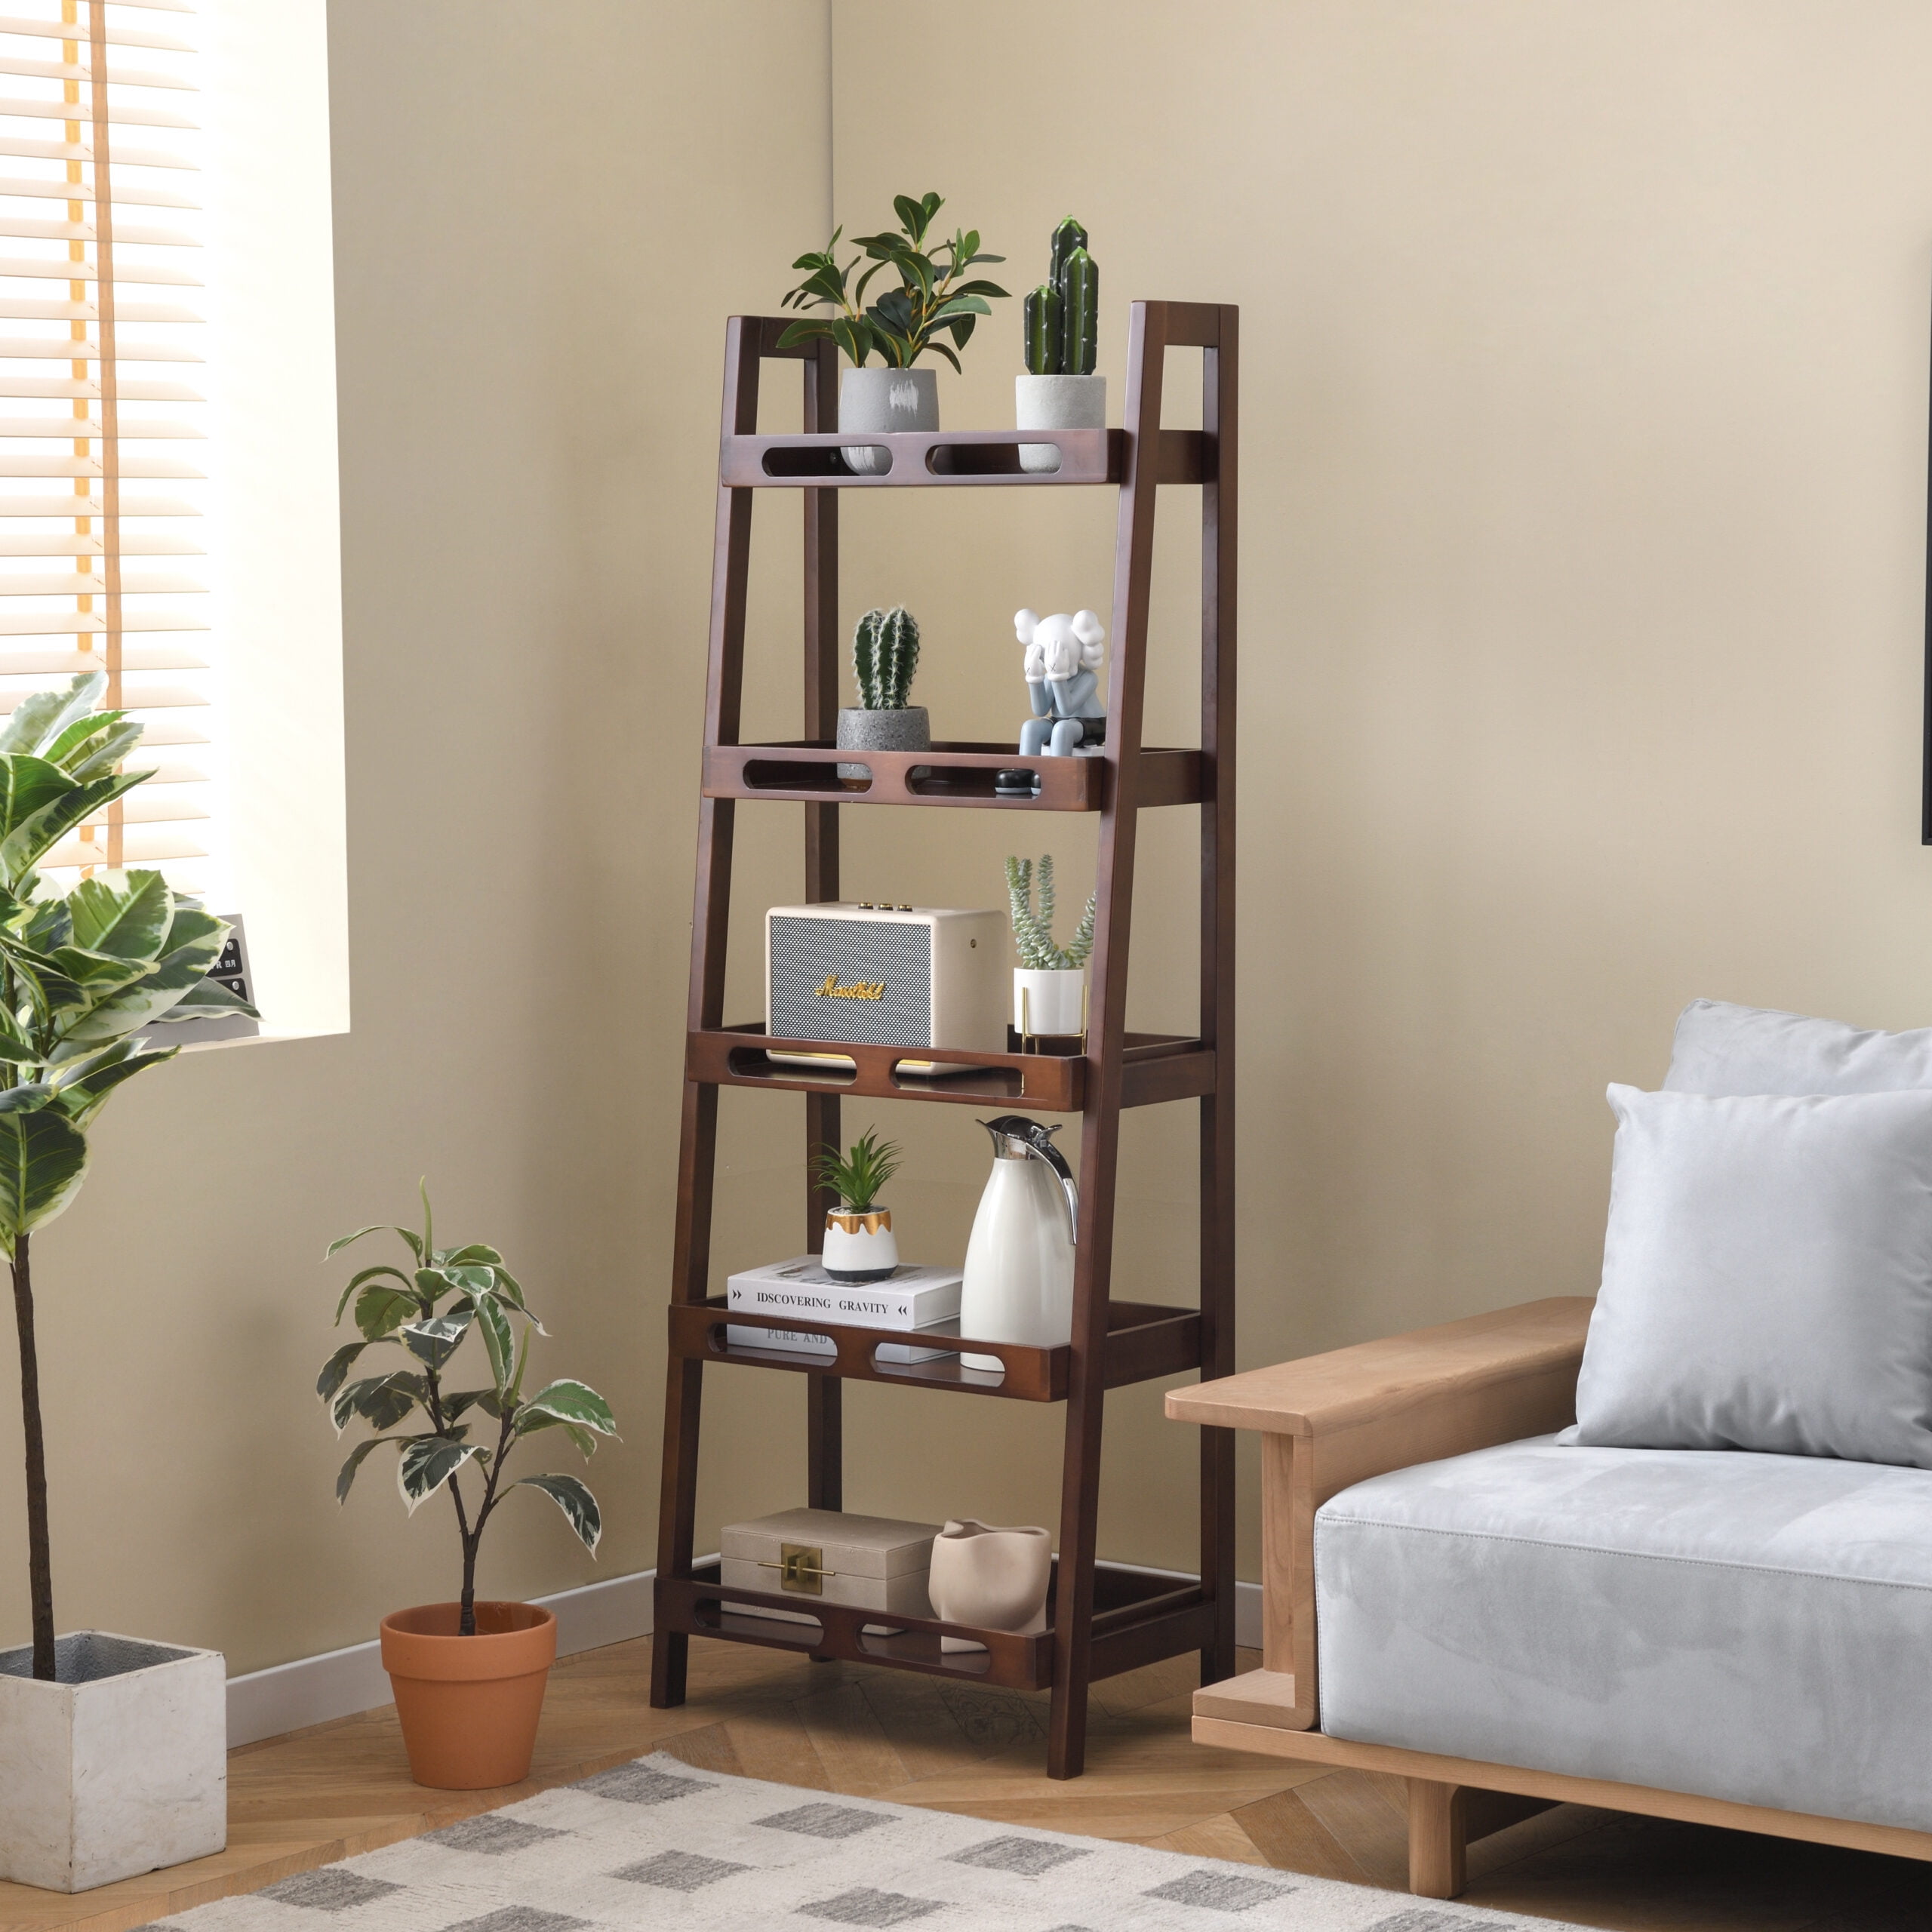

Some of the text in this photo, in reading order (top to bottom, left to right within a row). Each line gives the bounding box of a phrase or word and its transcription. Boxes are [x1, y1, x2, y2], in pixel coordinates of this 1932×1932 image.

[838, 1300, 888, 1314] GRAVITY
[768, 1329, 827, 1344] PURE AND
